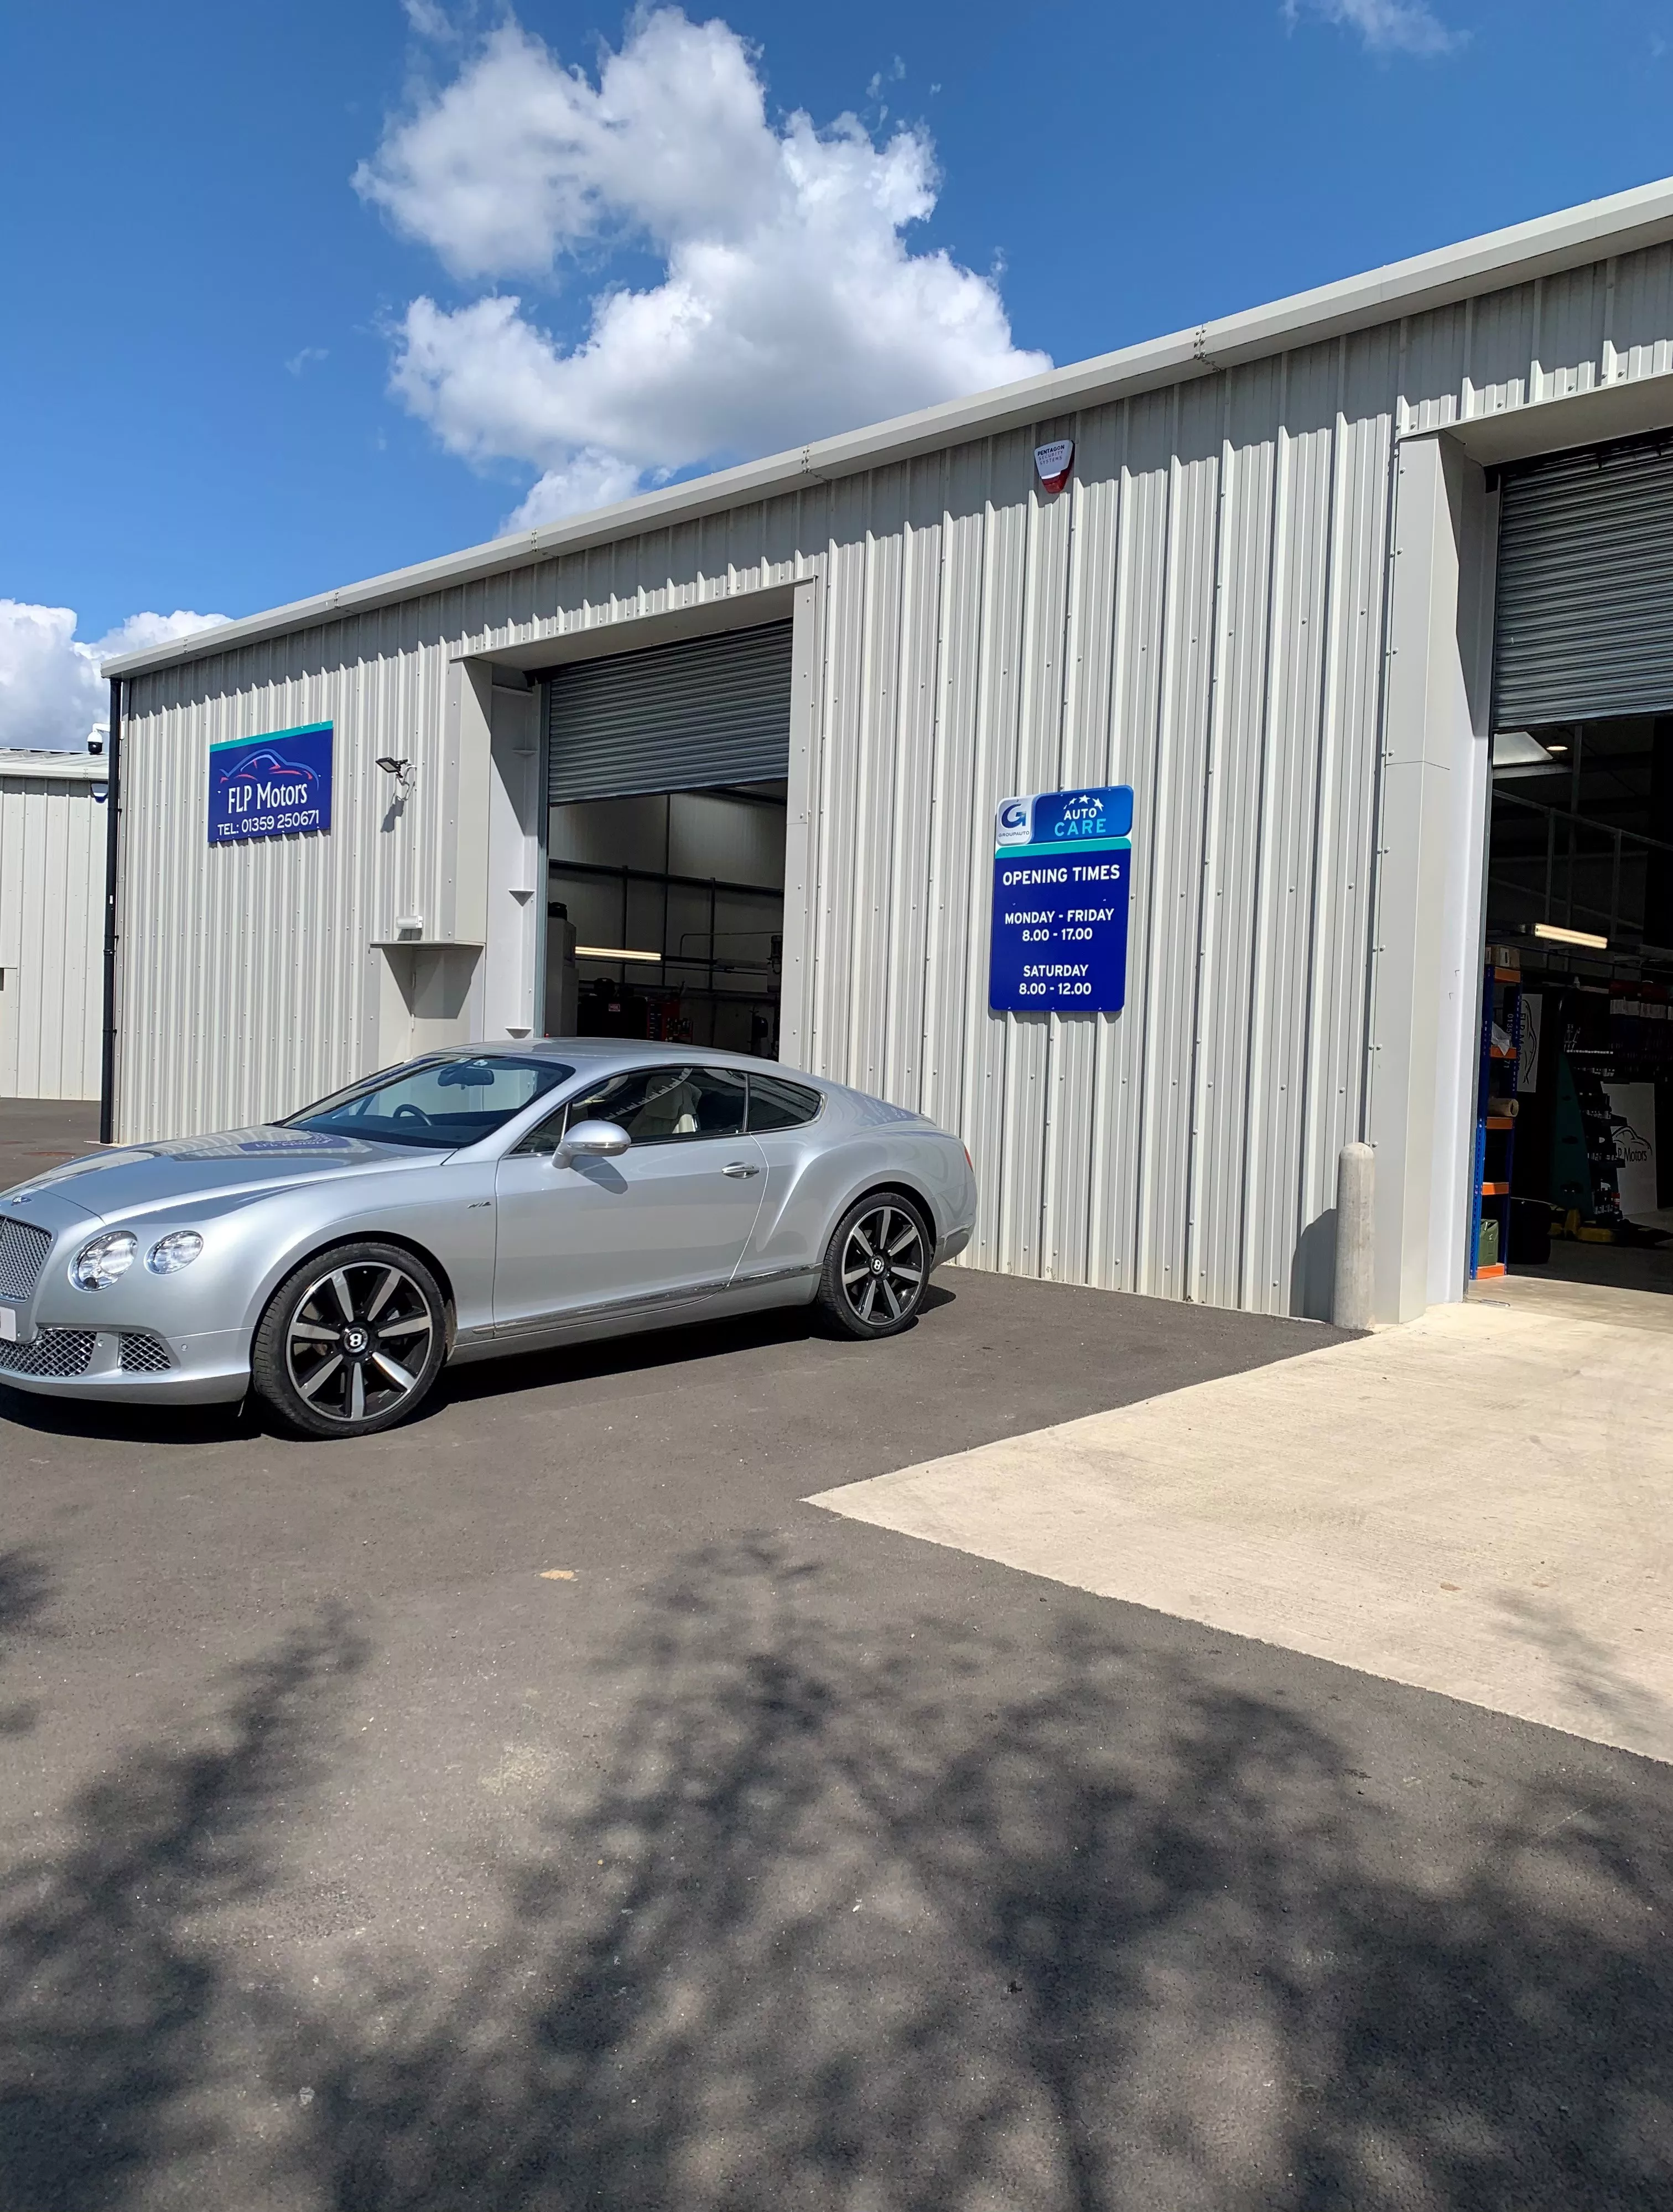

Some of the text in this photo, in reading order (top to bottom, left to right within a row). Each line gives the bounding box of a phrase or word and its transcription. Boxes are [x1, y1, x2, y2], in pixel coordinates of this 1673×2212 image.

[1037, 445, 1065, 456] PENTAGON
[1039, 450, 1063, 461] SECURITY
[1040, 456, 1062, 465] SYSTEMS
[228, 782, 308, 814] FLP Motors
[1063, 808, 1097, 820] AUTO
[217, 809, 319, 836] TEL: 01359 250671
[1054, 818, 1106, 836] CARE
[1002, 864, 1120, 886] OPENING TIMES
[1005, 910, 1056, 925] MONDAY
[1067, 908, 1115, 922] FRIDAY
[1022, 929, 1049, 942] 8.00
[1061, 928, 1093, 940] 17.00
[1023, 964, 1089, 977] SATURDAY
[1019, 982, 1046, 995] 8.00
[1058, 982, 1092, 995] 12.00
[1624, 1147, 1648, 1162] Motors
